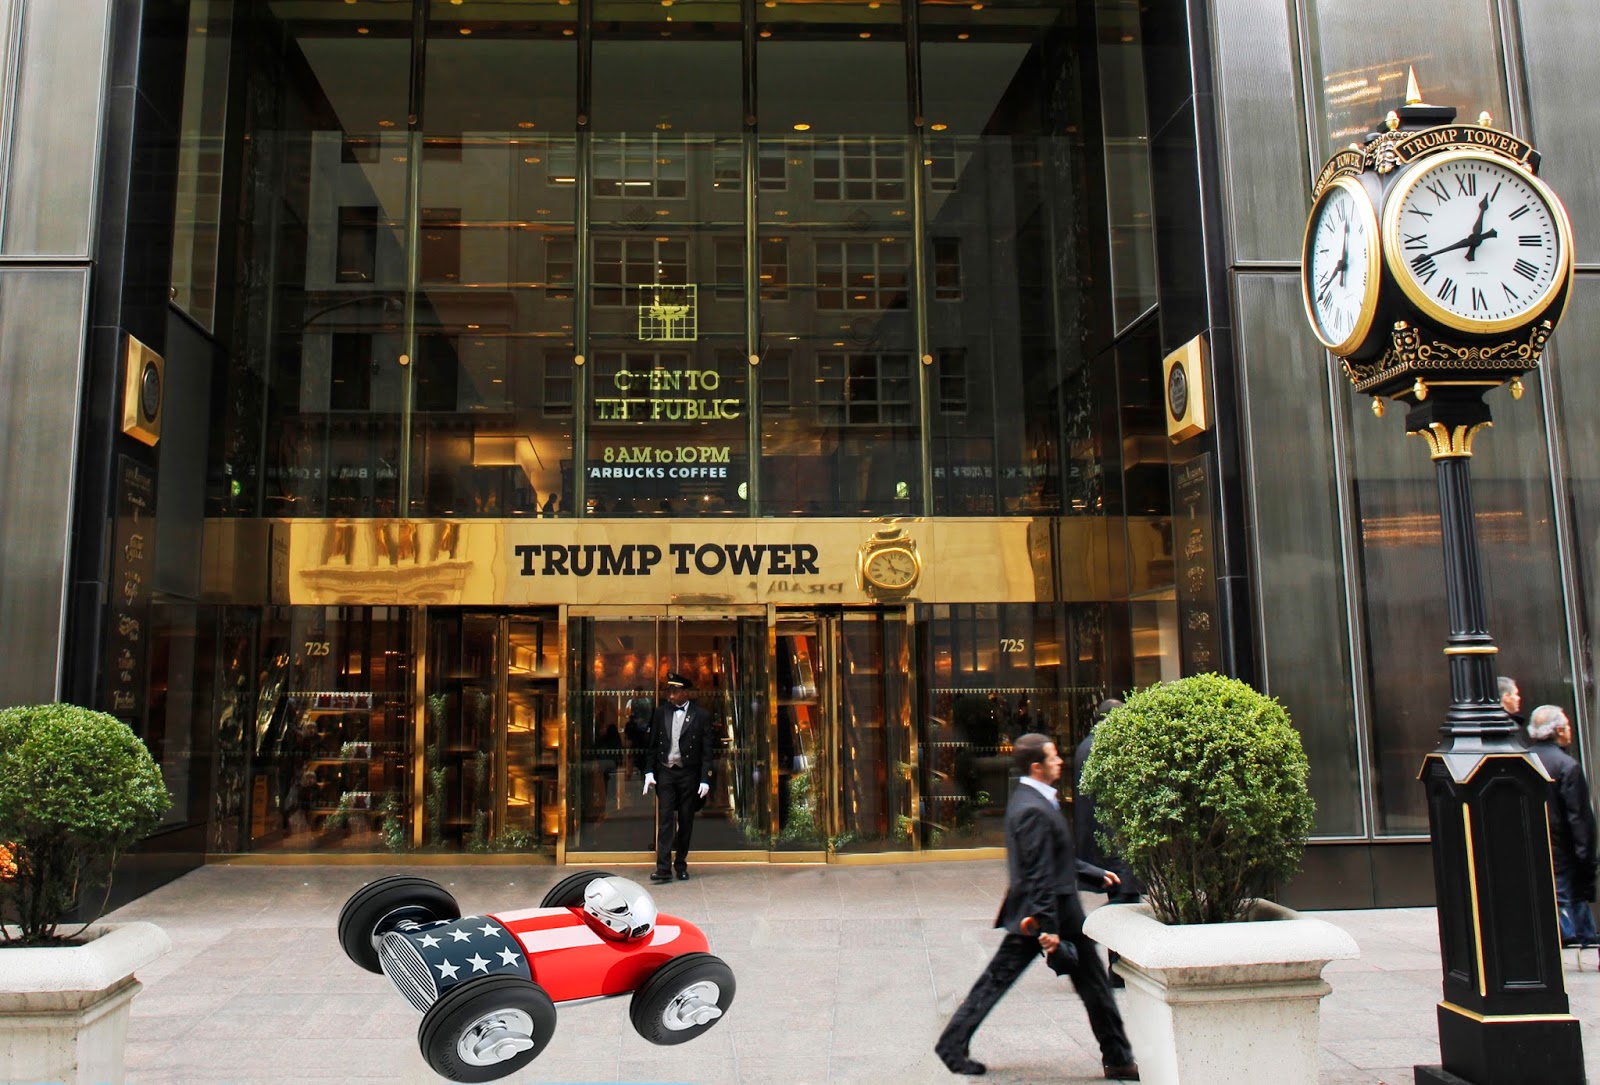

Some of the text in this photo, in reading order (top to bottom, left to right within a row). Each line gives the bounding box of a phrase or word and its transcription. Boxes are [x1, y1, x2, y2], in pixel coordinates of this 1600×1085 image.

[1403, 129, 1519, 156] TRUMP TOWER
[1336, 153, 1361, 168] TOWER
[613, 369, 720, 391] OEN TO
[595, 398, 740, 420] TH PUBLIC
[654, 448, 673, 463] to
[587, 467, 727, 478] ARBUCKS COFFEE
[515, 543, 819, 577] TRUMP TOWER
[305, 642, 330, 656] 725
[1000, 638, 1025, 653] 725
